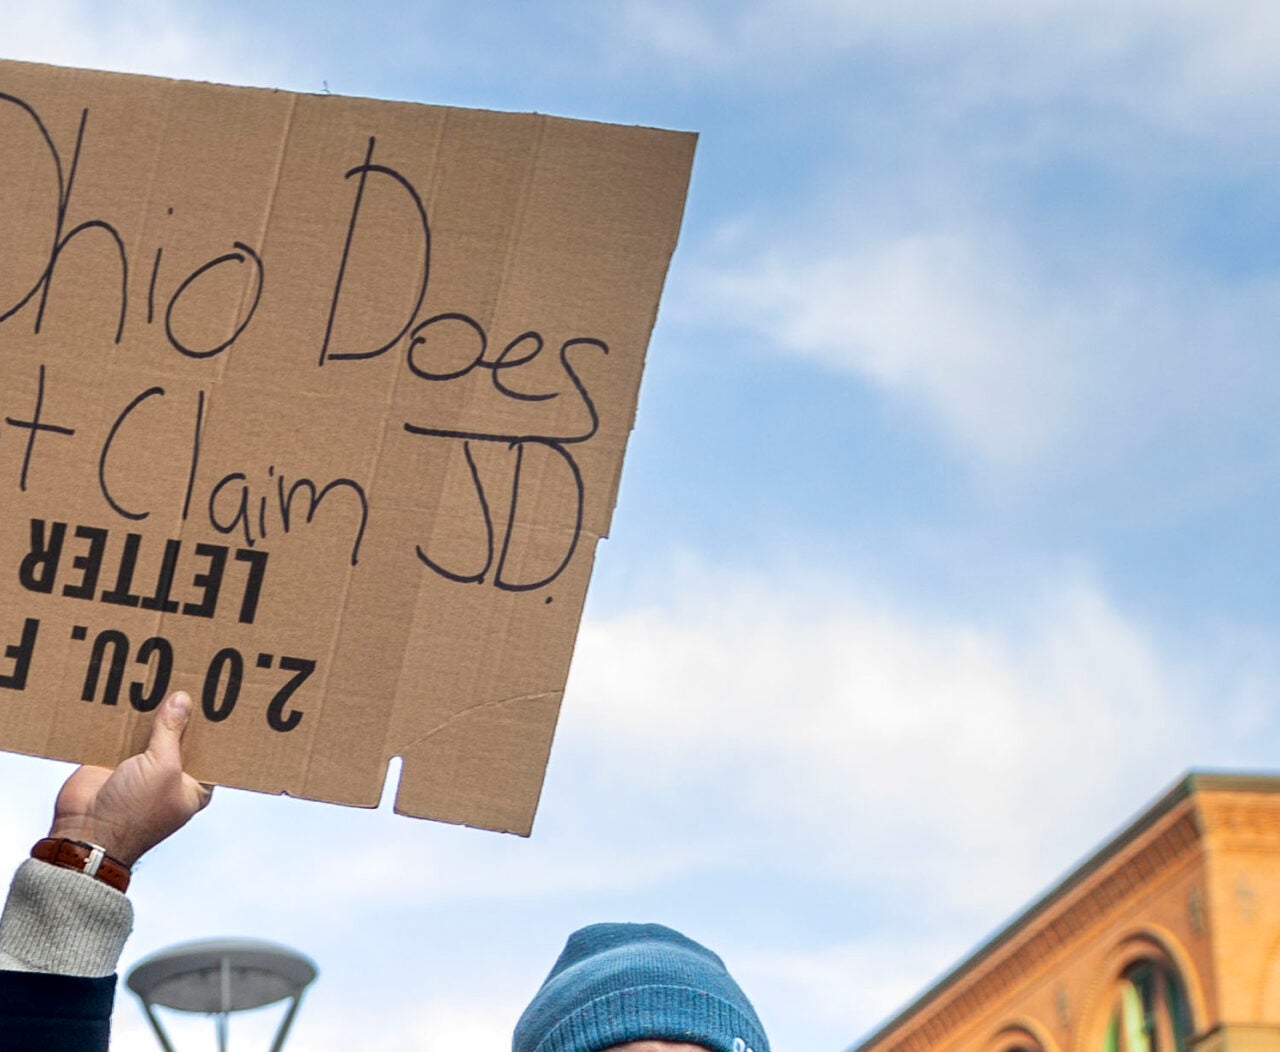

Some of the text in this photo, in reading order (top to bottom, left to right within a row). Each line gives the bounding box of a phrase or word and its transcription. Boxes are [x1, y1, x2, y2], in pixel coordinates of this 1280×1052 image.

[319, 136, 609, 443] Does
[98, 387, 370, 565] Claim
[404, 422, 584, 605] JD.
[18, 518, 269, 625] LETTER
[70, 624, 174, 712] CU.
[200, 647, 317, 733] 2.0
